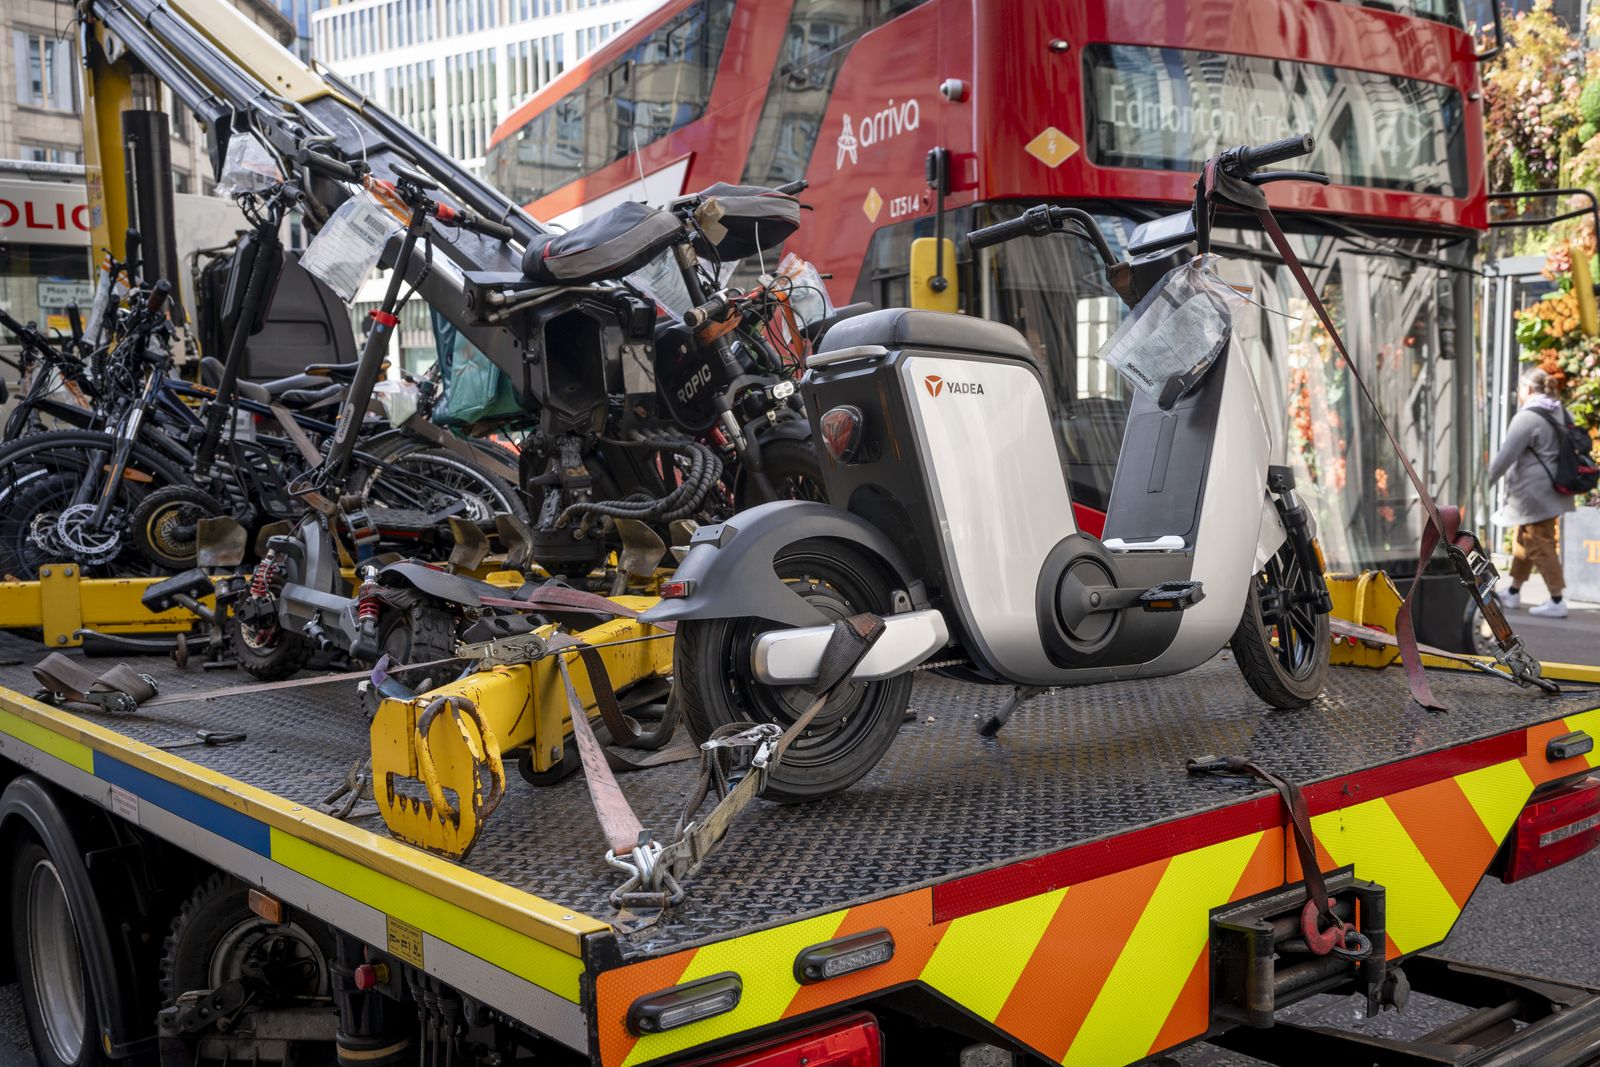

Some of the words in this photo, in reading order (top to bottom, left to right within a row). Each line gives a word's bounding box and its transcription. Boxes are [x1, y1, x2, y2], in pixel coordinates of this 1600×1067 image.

[859, 98, 919, 147] arriva
[1110, 86, 1237, 138] Edmonton
[890, 194, 919, 217] LT514
[946, 381, 984, 395] YADEA
